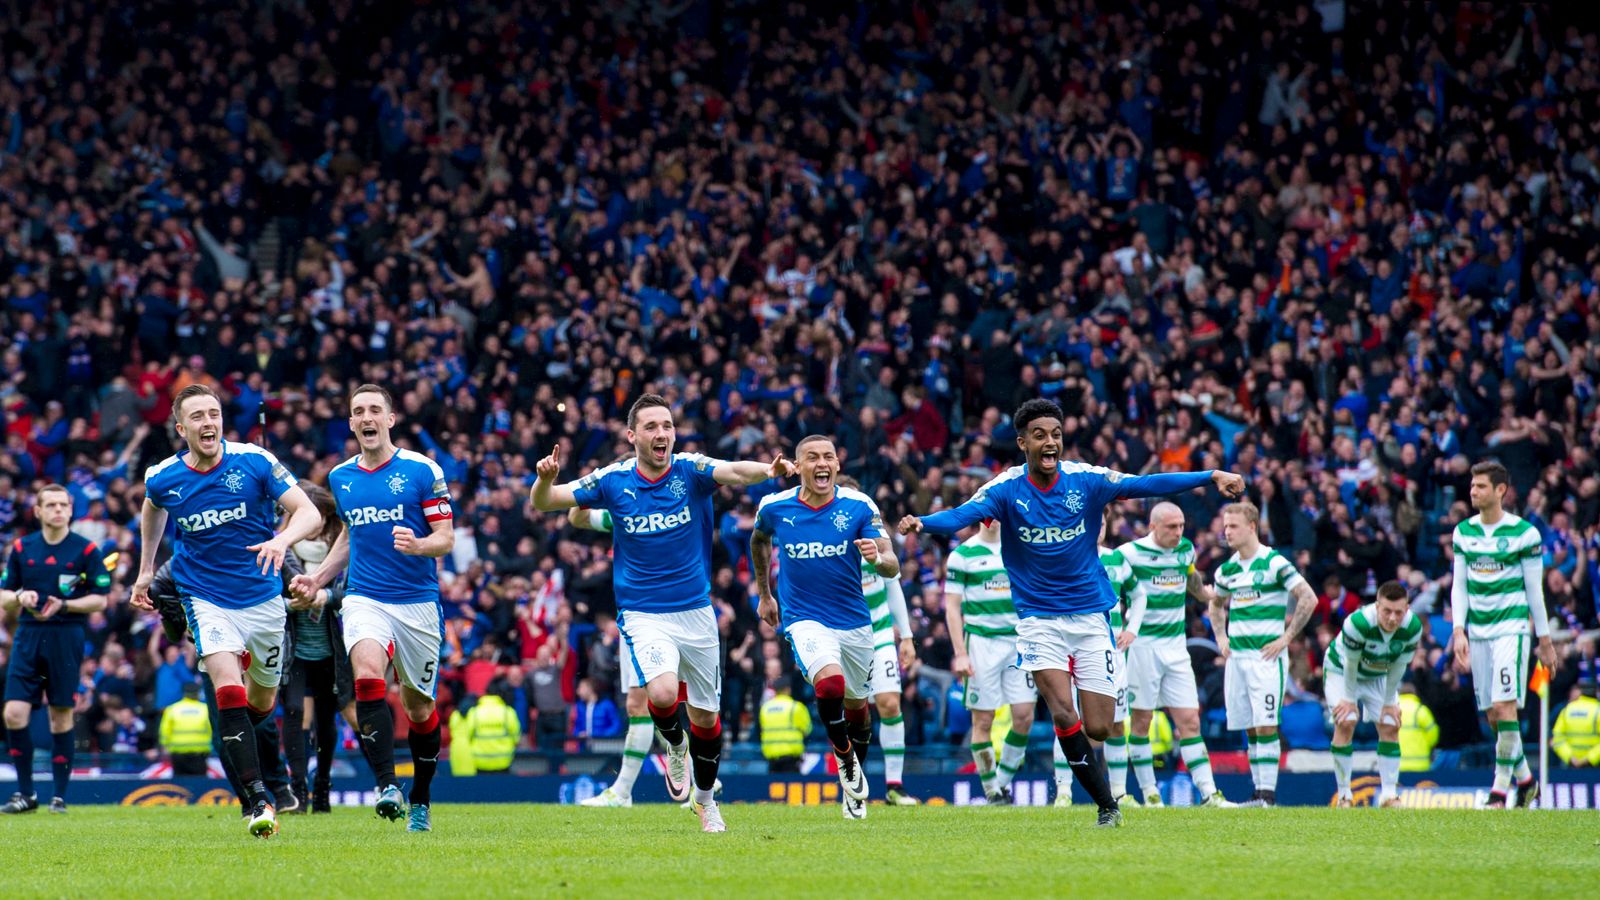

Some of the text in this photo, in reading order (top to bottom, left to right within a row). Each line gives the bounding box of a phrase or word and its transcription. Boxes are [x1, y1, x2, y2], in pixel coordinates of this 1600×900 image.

[178, 502, 247, 532] 32Red
[345, 504, 404, 527] 32Red
[623, 506, 692, 533] 32Red
[1018, 518, 1087, 544] 32Red
[785, 540, 848, 559] 32Red
[421, 661, 435, 684] 5
[1105, 650, 1115, 675] 8
[1500, 667, 1511, 686] 6
[1265, 694, 1275, 711] 9
